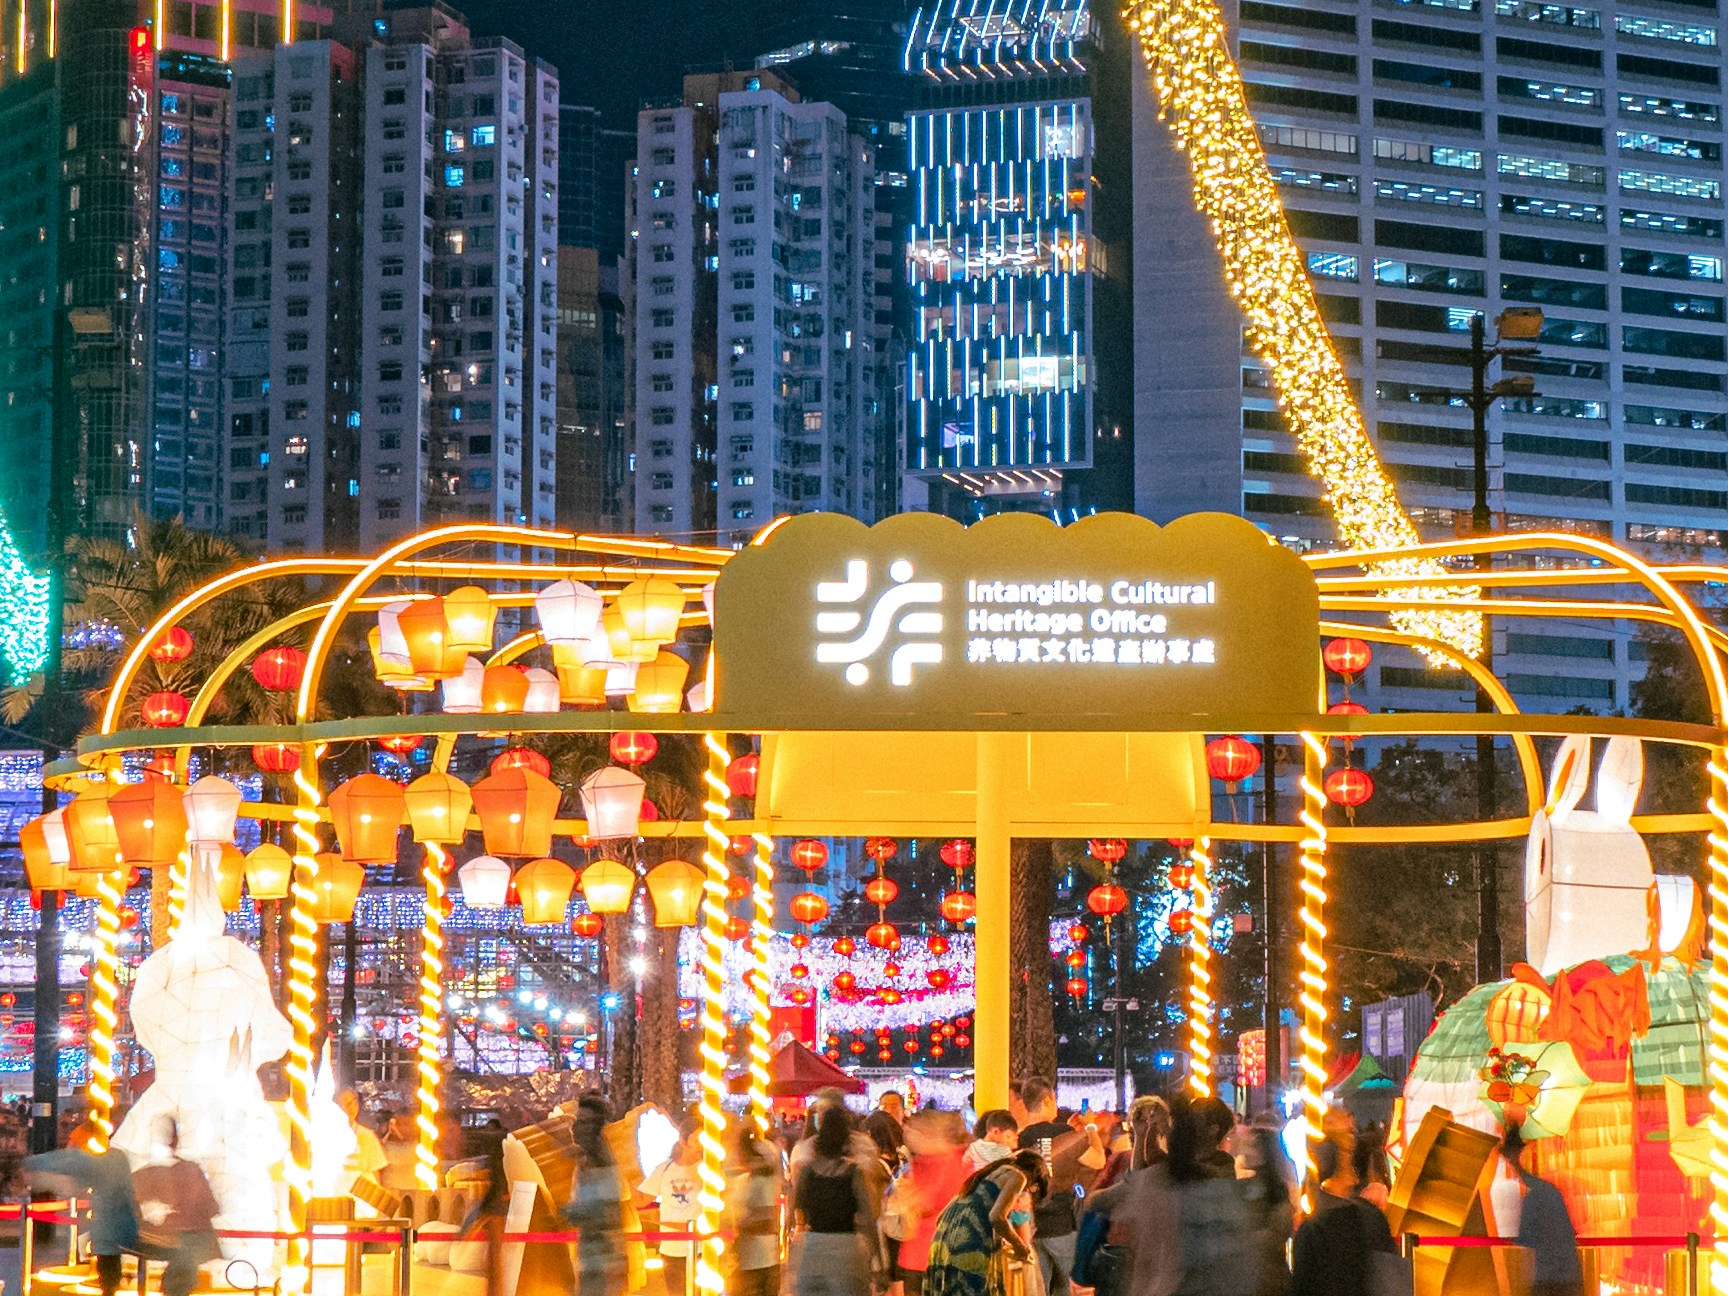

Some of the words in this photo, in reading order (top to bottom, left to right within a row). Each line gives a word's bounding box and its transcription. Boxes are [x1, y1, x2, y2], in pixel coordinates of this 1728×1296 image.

[967, 579, 1104, 606] Intangible
[1110, 580, 1215, 605] Cultural
[967, 608, 1084, 635] Heritage
[1090, 608, 1168, 633] Office
